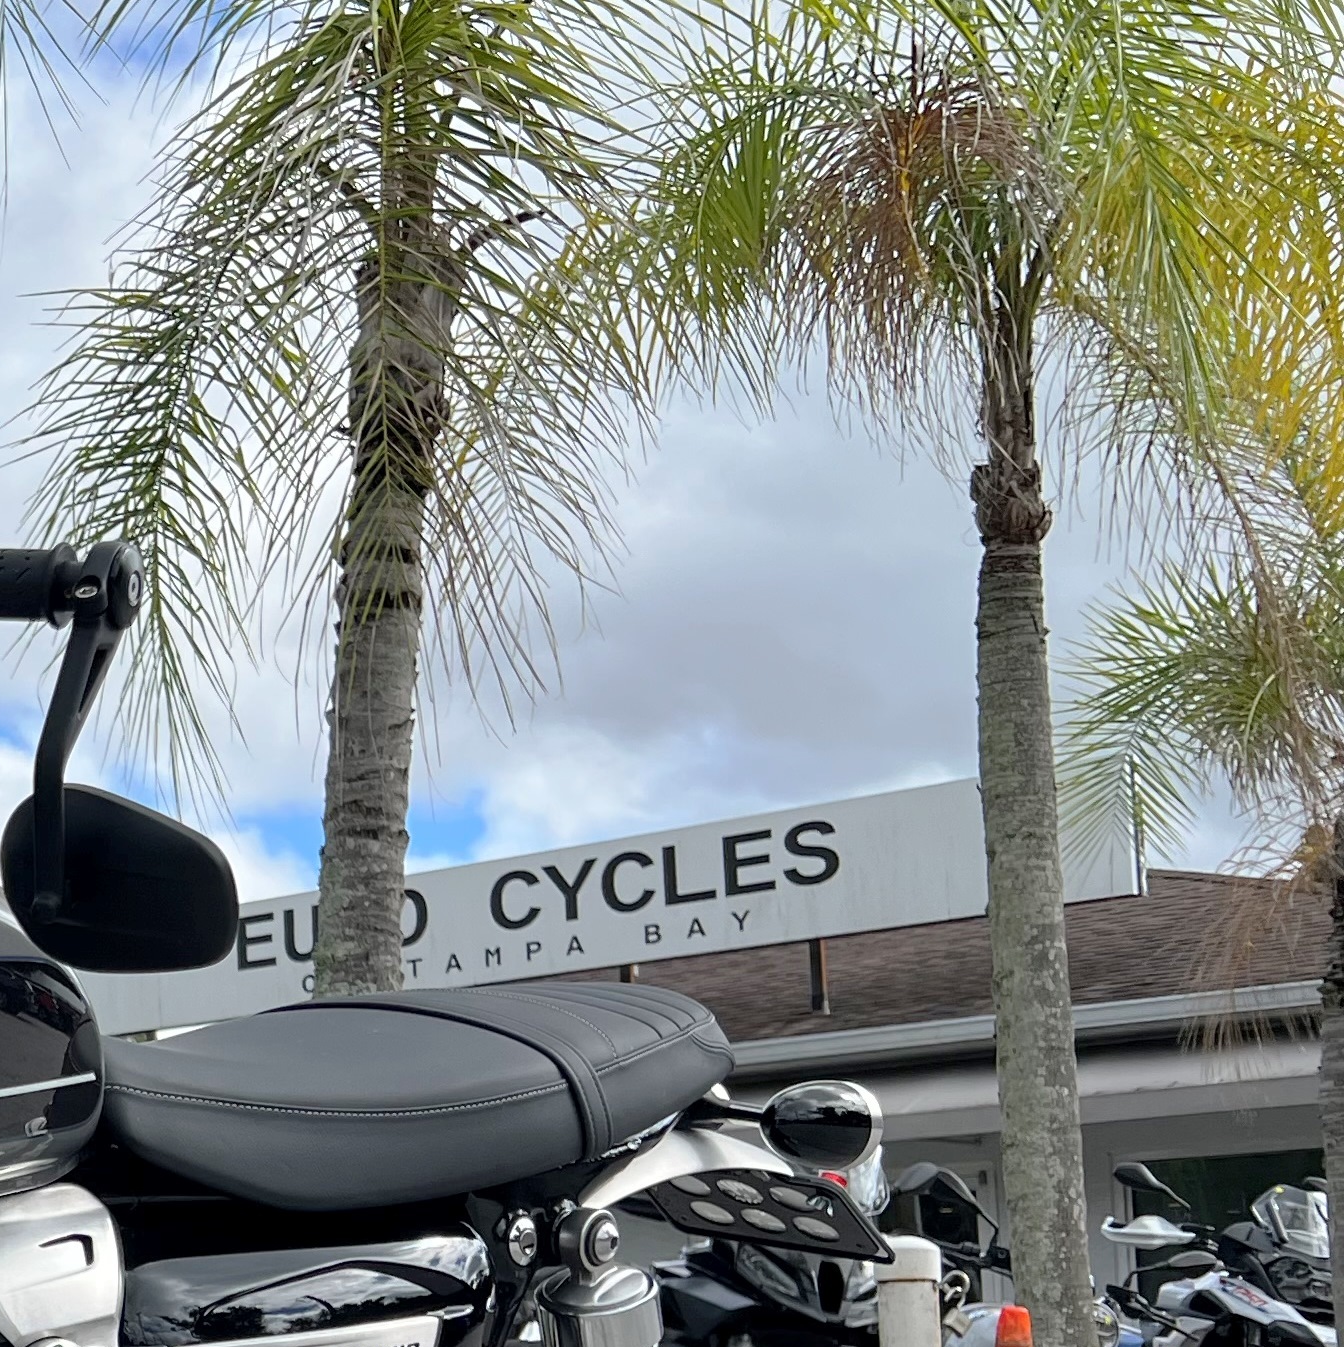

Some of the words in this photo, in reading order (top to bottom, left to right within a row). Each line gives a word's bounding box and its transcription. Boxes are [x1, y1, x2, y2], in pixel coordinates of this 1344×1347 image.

[490, 820, 840, 930] CYCLES
[406, 936, 585, 978] TAMPA
[644, 909, 750, 945] BAY
